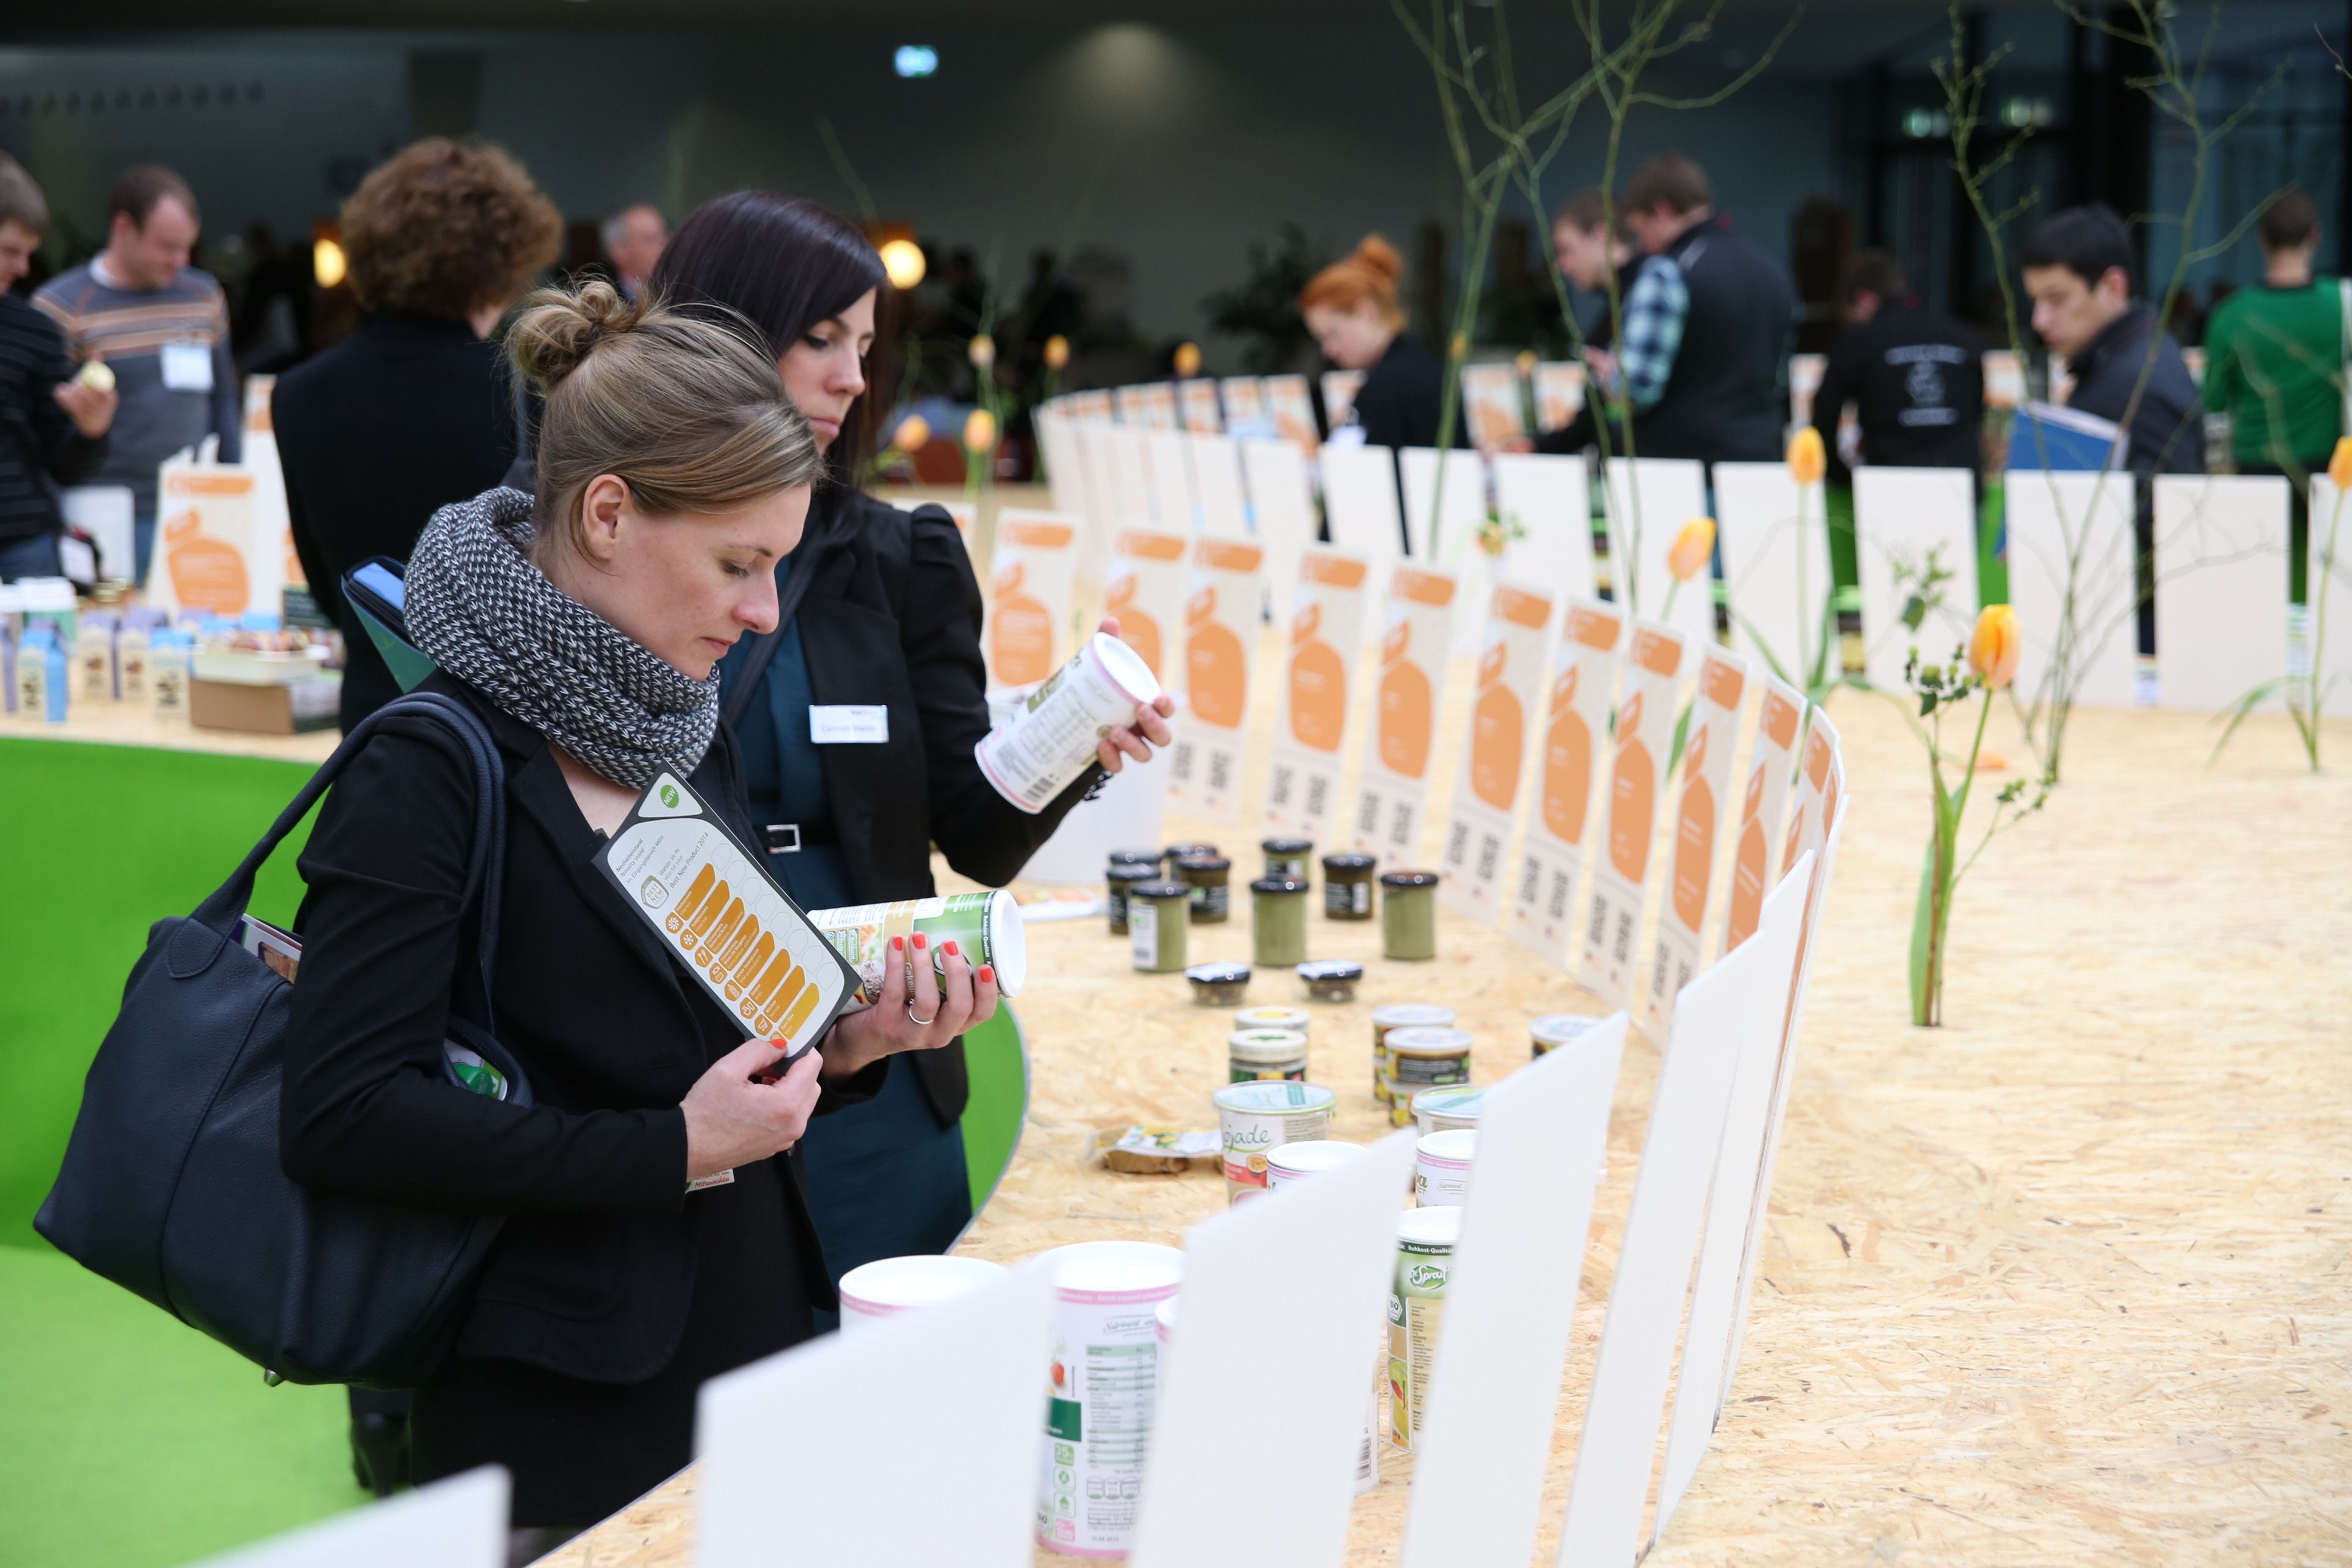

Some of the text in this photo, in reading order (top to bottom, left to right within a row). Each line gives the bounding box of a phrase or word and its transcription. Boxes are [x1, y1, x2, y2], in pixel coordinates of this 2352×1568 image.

[663, 786, 676, 805] NEW
[616, 838, 643, 873] Neuheitenstand
[620, 847, 645, 878] Novelty stand
[631, 845, 657, 880] Eingangsbereich
[654, 834, 665, 847] Mitte
[658, 859, 672, 876] Wählen
[663, 869, 673, 881] Vote
[674, 854, 685, 867] your
[668, 831, 709, 889] Best New Product 2014
[646, 883, 658, 899] BEST
[650, 888, 663, 903] NEW
[1224, 1123, 1271, 1153] ojade
[1408, 1245, 1454, 1254] Rohkost-Qualität
[1413, 1265, 1448, 1286] Sprout
